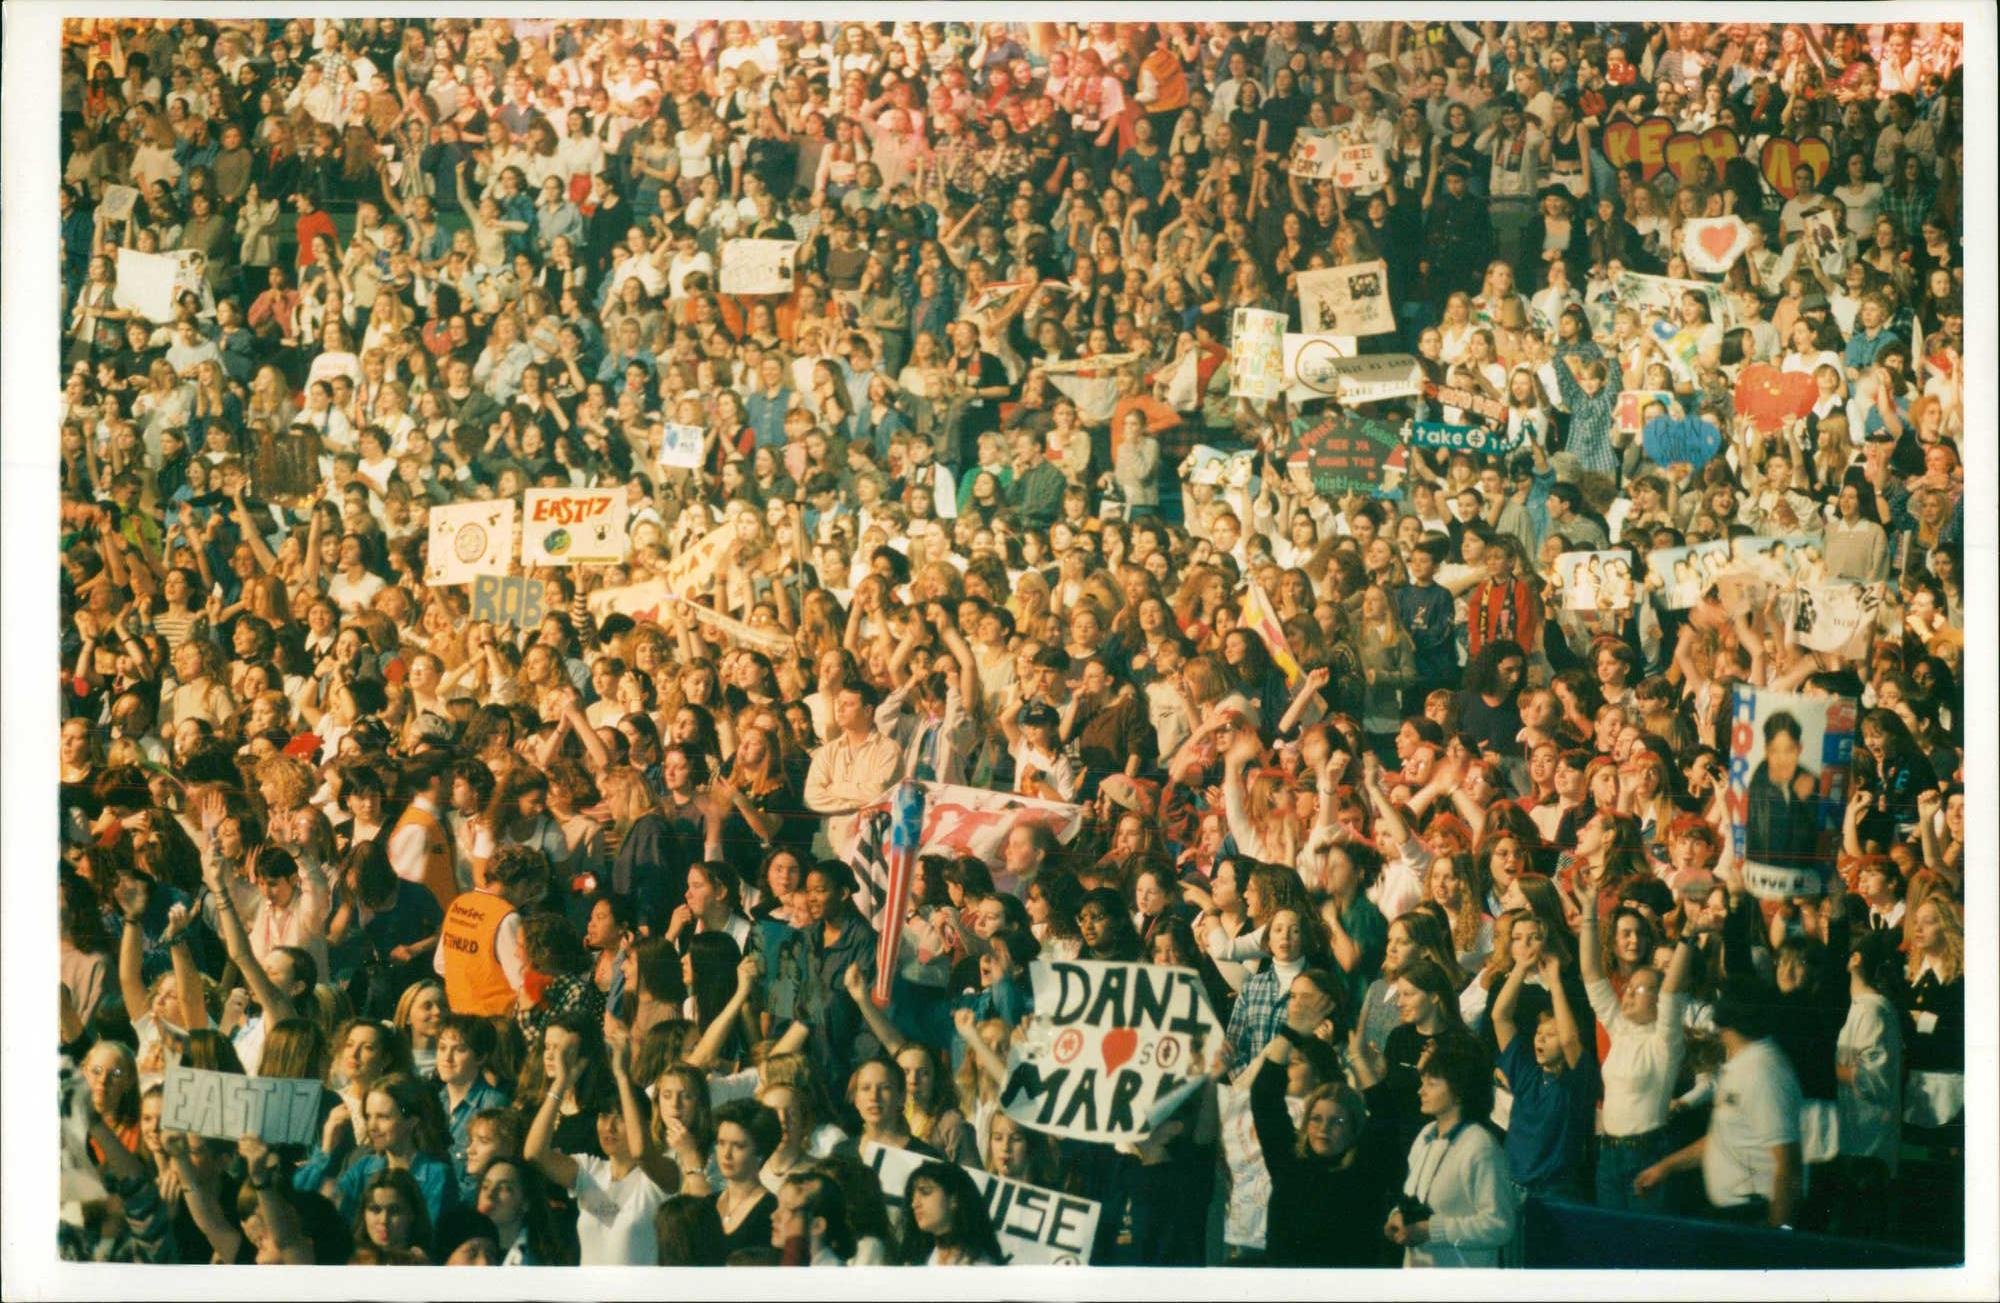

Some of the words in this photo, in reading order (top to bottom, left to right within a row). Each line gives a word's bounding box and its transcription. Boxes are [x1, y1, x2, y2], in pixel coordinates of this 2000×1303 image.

[1416, 426, 1463, 446] take
[473, 575, 544, 627] ROB
[1051, 961, 1213, 1035] DANI
